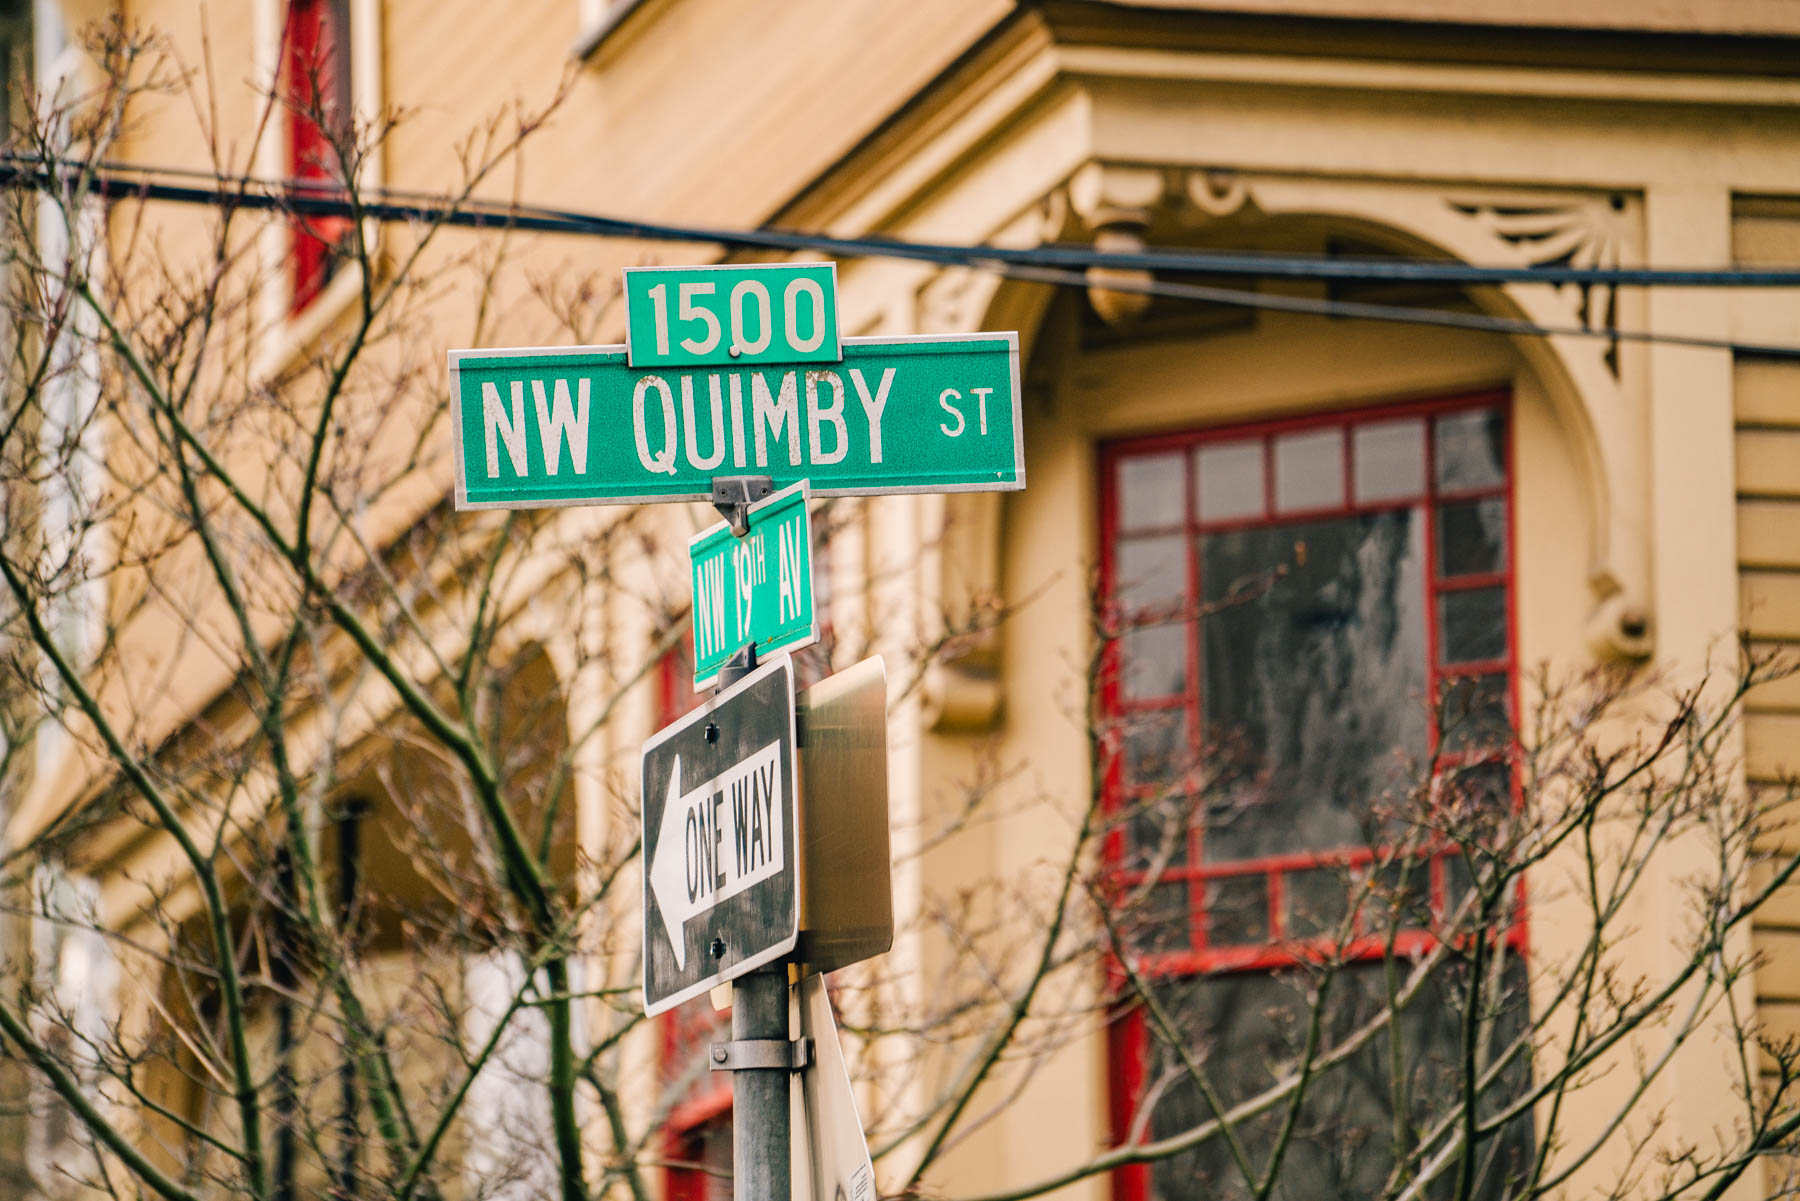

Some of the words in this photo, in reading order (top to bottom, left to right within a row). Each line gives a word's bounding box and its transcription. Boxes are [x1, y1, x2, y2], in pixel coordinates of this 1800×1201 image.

[647, 277, 826, 356] 1500
[481, 378, 591, 479] NW
[632, 367, 897, 477] QUIMBY
[939, 387, 994, 438] ST
[697, 551, 726, 661] NW
[779, 515, 801, 625] AV
[686, 789, 727, 905] ONE
[732, 759, 775, 880] WAY
